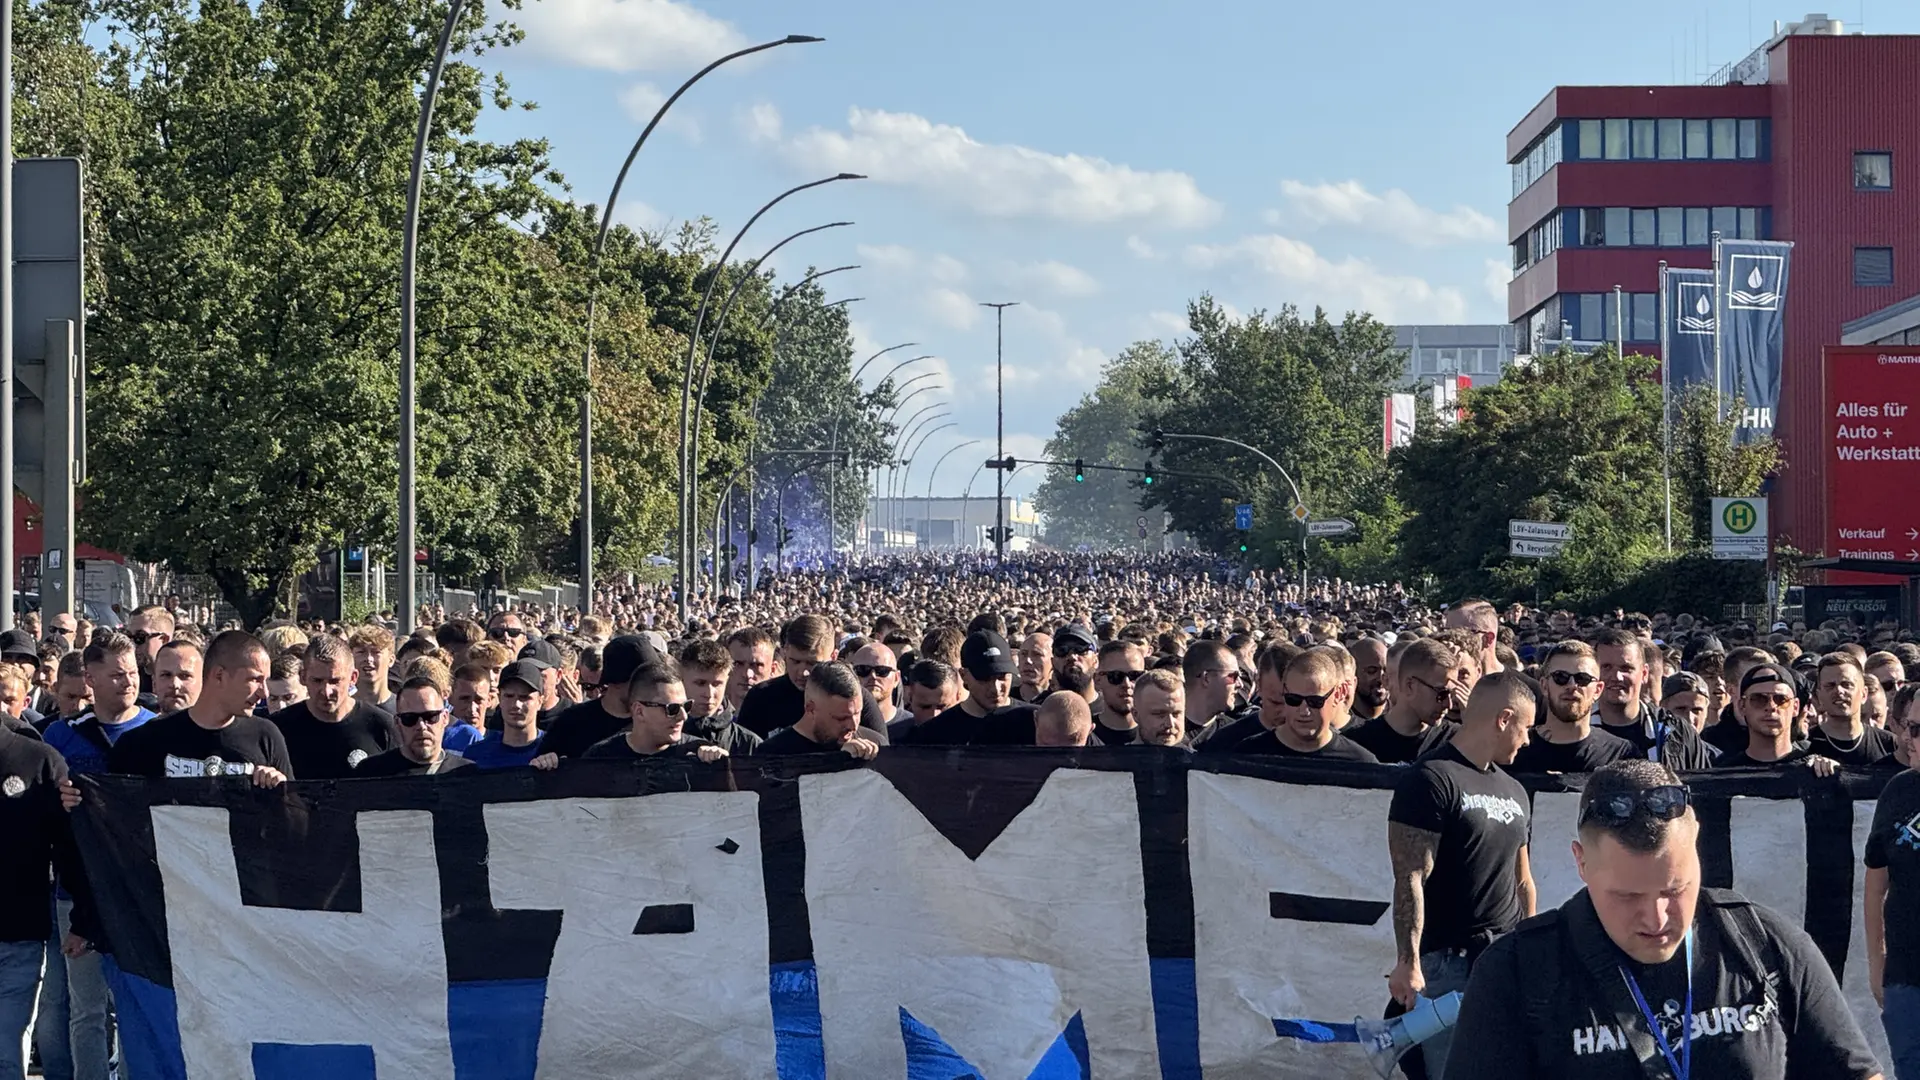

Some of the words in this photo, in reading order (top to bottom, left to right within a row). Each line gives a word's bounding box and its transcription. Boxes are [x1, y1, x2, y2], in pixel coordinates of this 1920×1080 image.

[1836, 403, 1879, 417] Alles
[1883, 402, 1908, 417] für
[1836, 424, 1877, 439] Auto
[1836, 446, 1920, 460] Werkstatt
[1732, 508, 1748, 526] H
[1838, 528, 1886, 539] Verkauf
[1838, 548, 1895, 560] Trainings
[1826, 603, 1851, 612] NEUE
